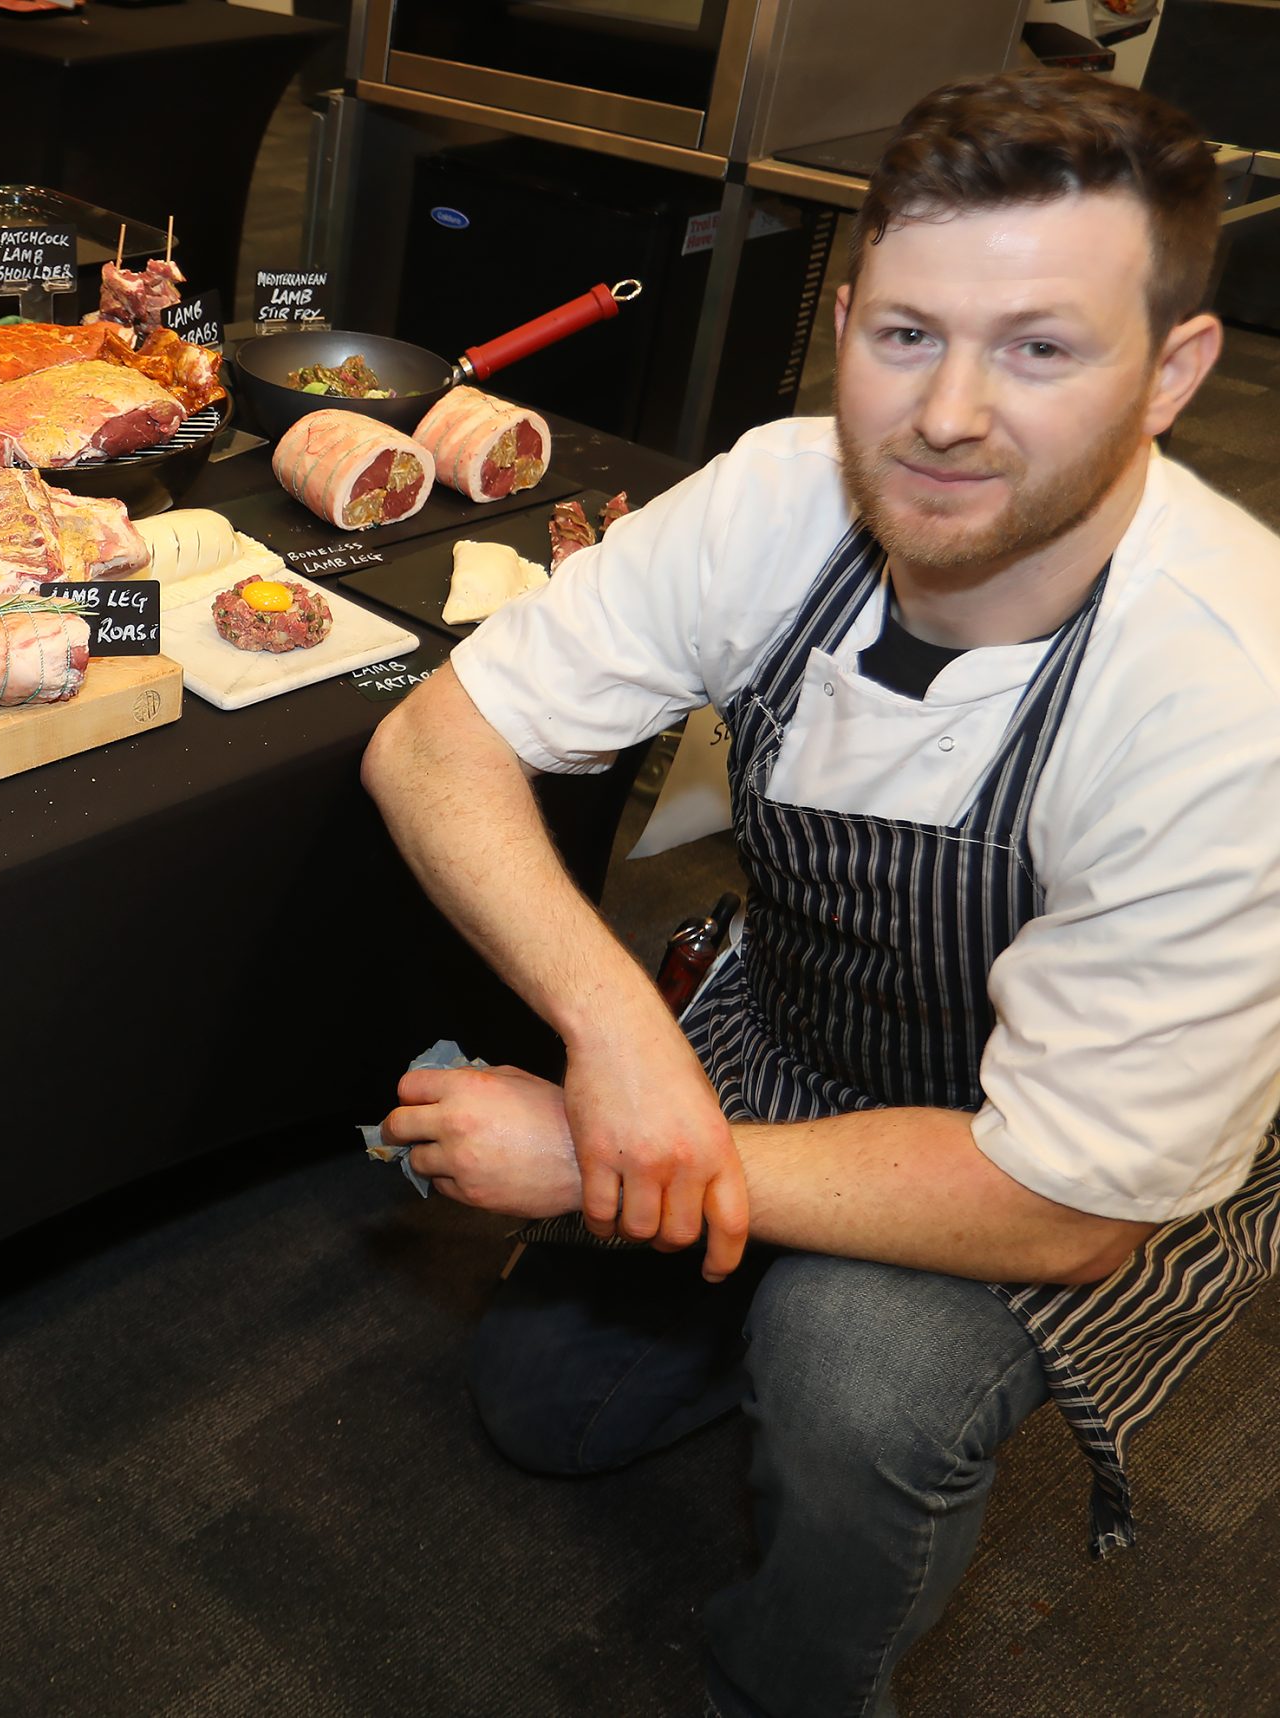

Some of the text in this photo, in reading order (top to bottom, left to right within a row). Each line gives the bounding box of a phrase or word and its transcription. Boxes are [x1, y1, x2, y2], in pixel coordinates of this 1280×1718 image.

[2, 247, 44, 266] LAMB
[270, 288, 313, 306] LAMB
[167, 299, 203, 329] LAMB
[258, 306, 322, 324] STIR FRY
[181, 321, 218, 345] BABS
[286, 542, 364, 562] BONELESS
[303, 552, 384, 574] LAMB LEG
[107, 588, 149, 614] LEG
[352, 661, 407, 678] LAMB
